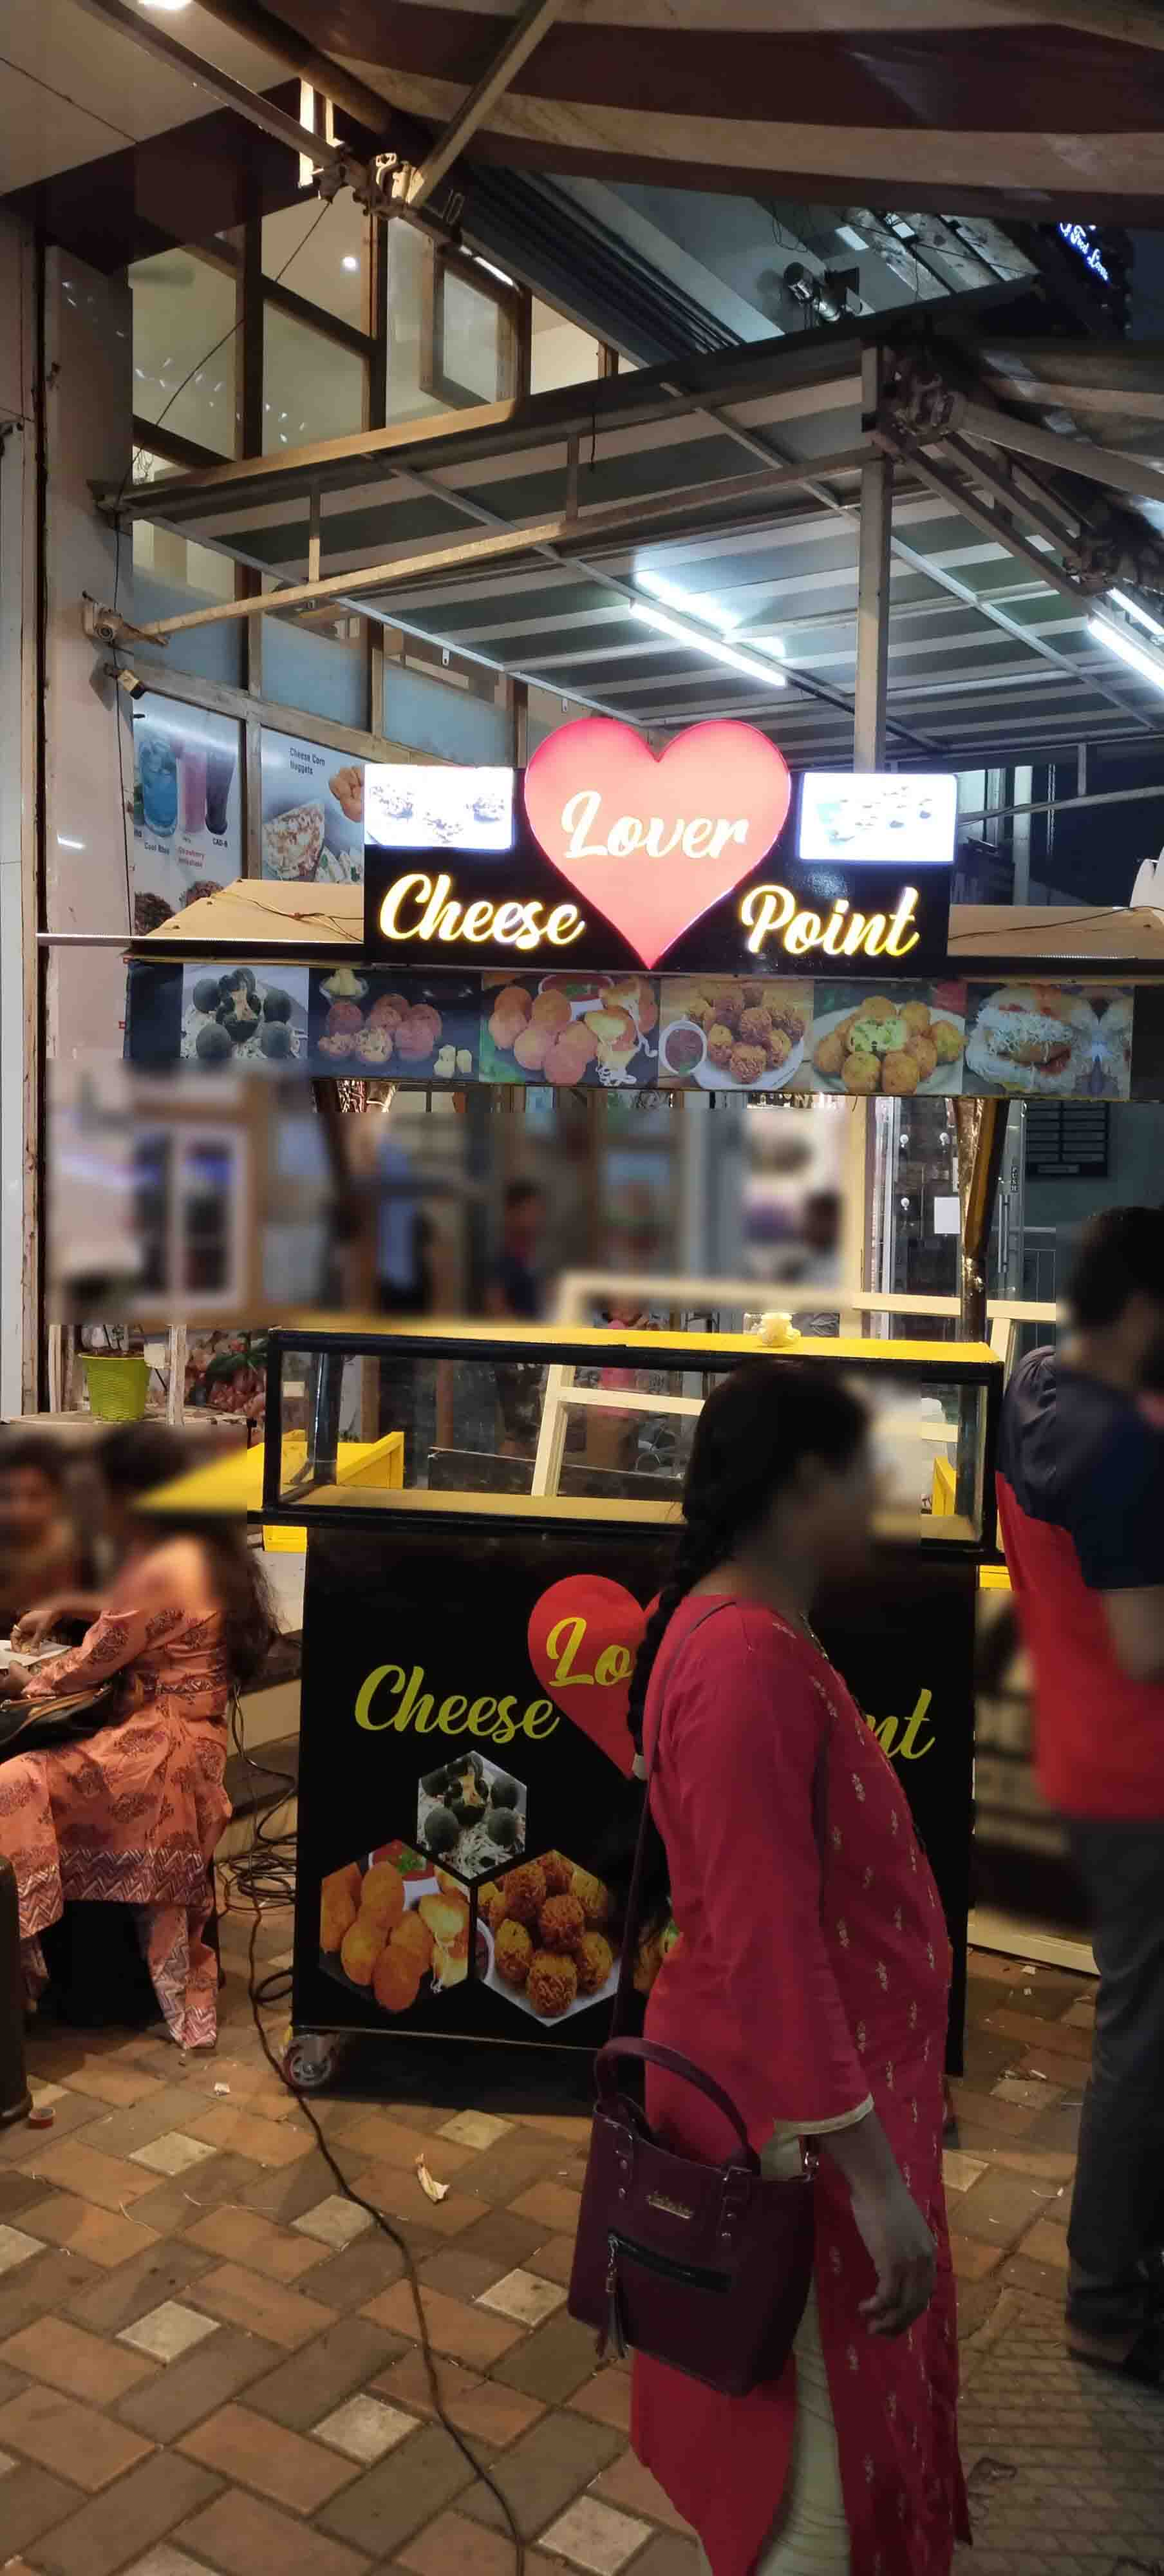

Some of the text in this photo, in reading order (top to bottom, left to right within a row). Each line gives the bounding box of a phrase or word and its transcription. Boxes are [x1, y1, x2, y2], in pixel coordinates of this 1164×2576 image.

[289, 747, 325, 766] Cheese Corn
[561, 790, 749, 860] Lover
[379, 873, 921, 956] Cheese Point
[354, 1664, 561, 1743] Cheese
